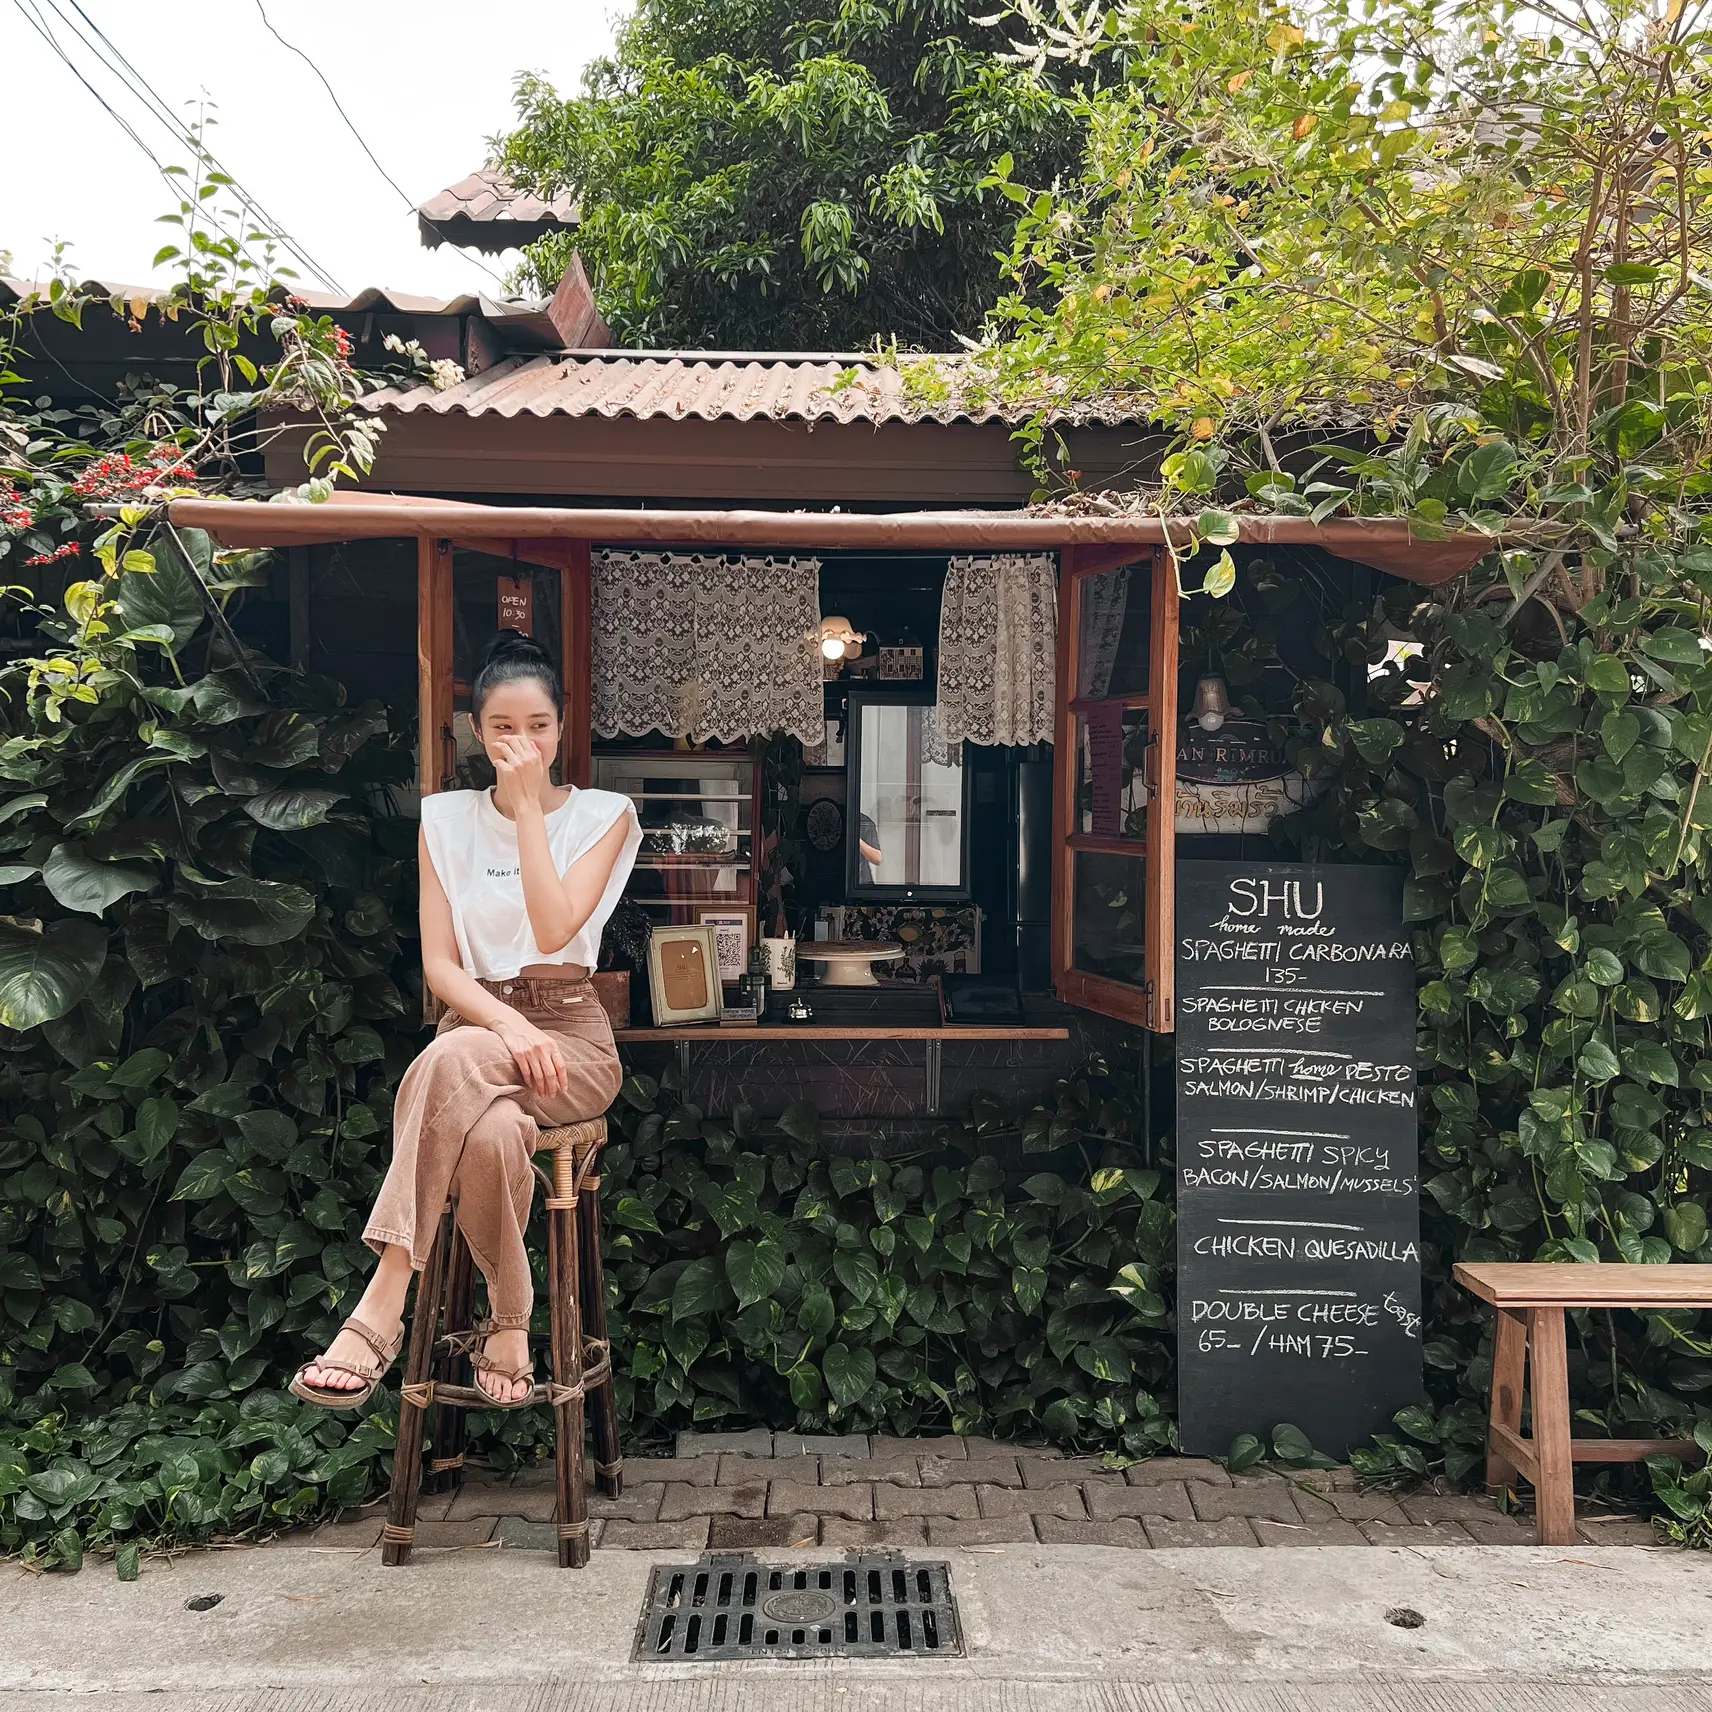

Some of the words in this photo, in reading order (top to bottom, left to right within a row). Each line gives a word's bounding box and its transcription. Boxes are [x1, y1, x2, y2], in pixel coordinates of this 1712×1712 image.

[501, 596, 527, 606] OPEN
[1215, 747, 1287, 765] RIMRU
[487, 868, 511, 877] Make
[514, 867, 520, 875] it
[1228, 878, 1323, 918] SHU
[1209, 915, 1262, 934] home
[1276, 922, 1337, 937] made
[1181, 938, 1281, 963] SPAGHETTI
[1289, 942, 1415, 962] CARBONARA
[1181, 997, 1279, 1015] SPAGHETTI
[1208, 1016, 1322, 1034] BOLOGNESE
[1180, 1056, 1284, 1077] SPAGHETTI
[1287, 1056, 1343, 1078] home
[1345, 1061, 1413, 1082] PESTO
[1197, 1140, 1315, 1164] SPAGHETTI
[1321, 1146, 1391, 1172] SPICY
[1193, 1235, 1296, 1260] CHICKEN
[1304, 1239, 1420, 1263] QUESADILLA
[1190, 1300, 1292, 1324] DOUBLE
[1297, 1303, 1380, 1327] CHEESE
[1382, 1290, 1422, 1338] toast
